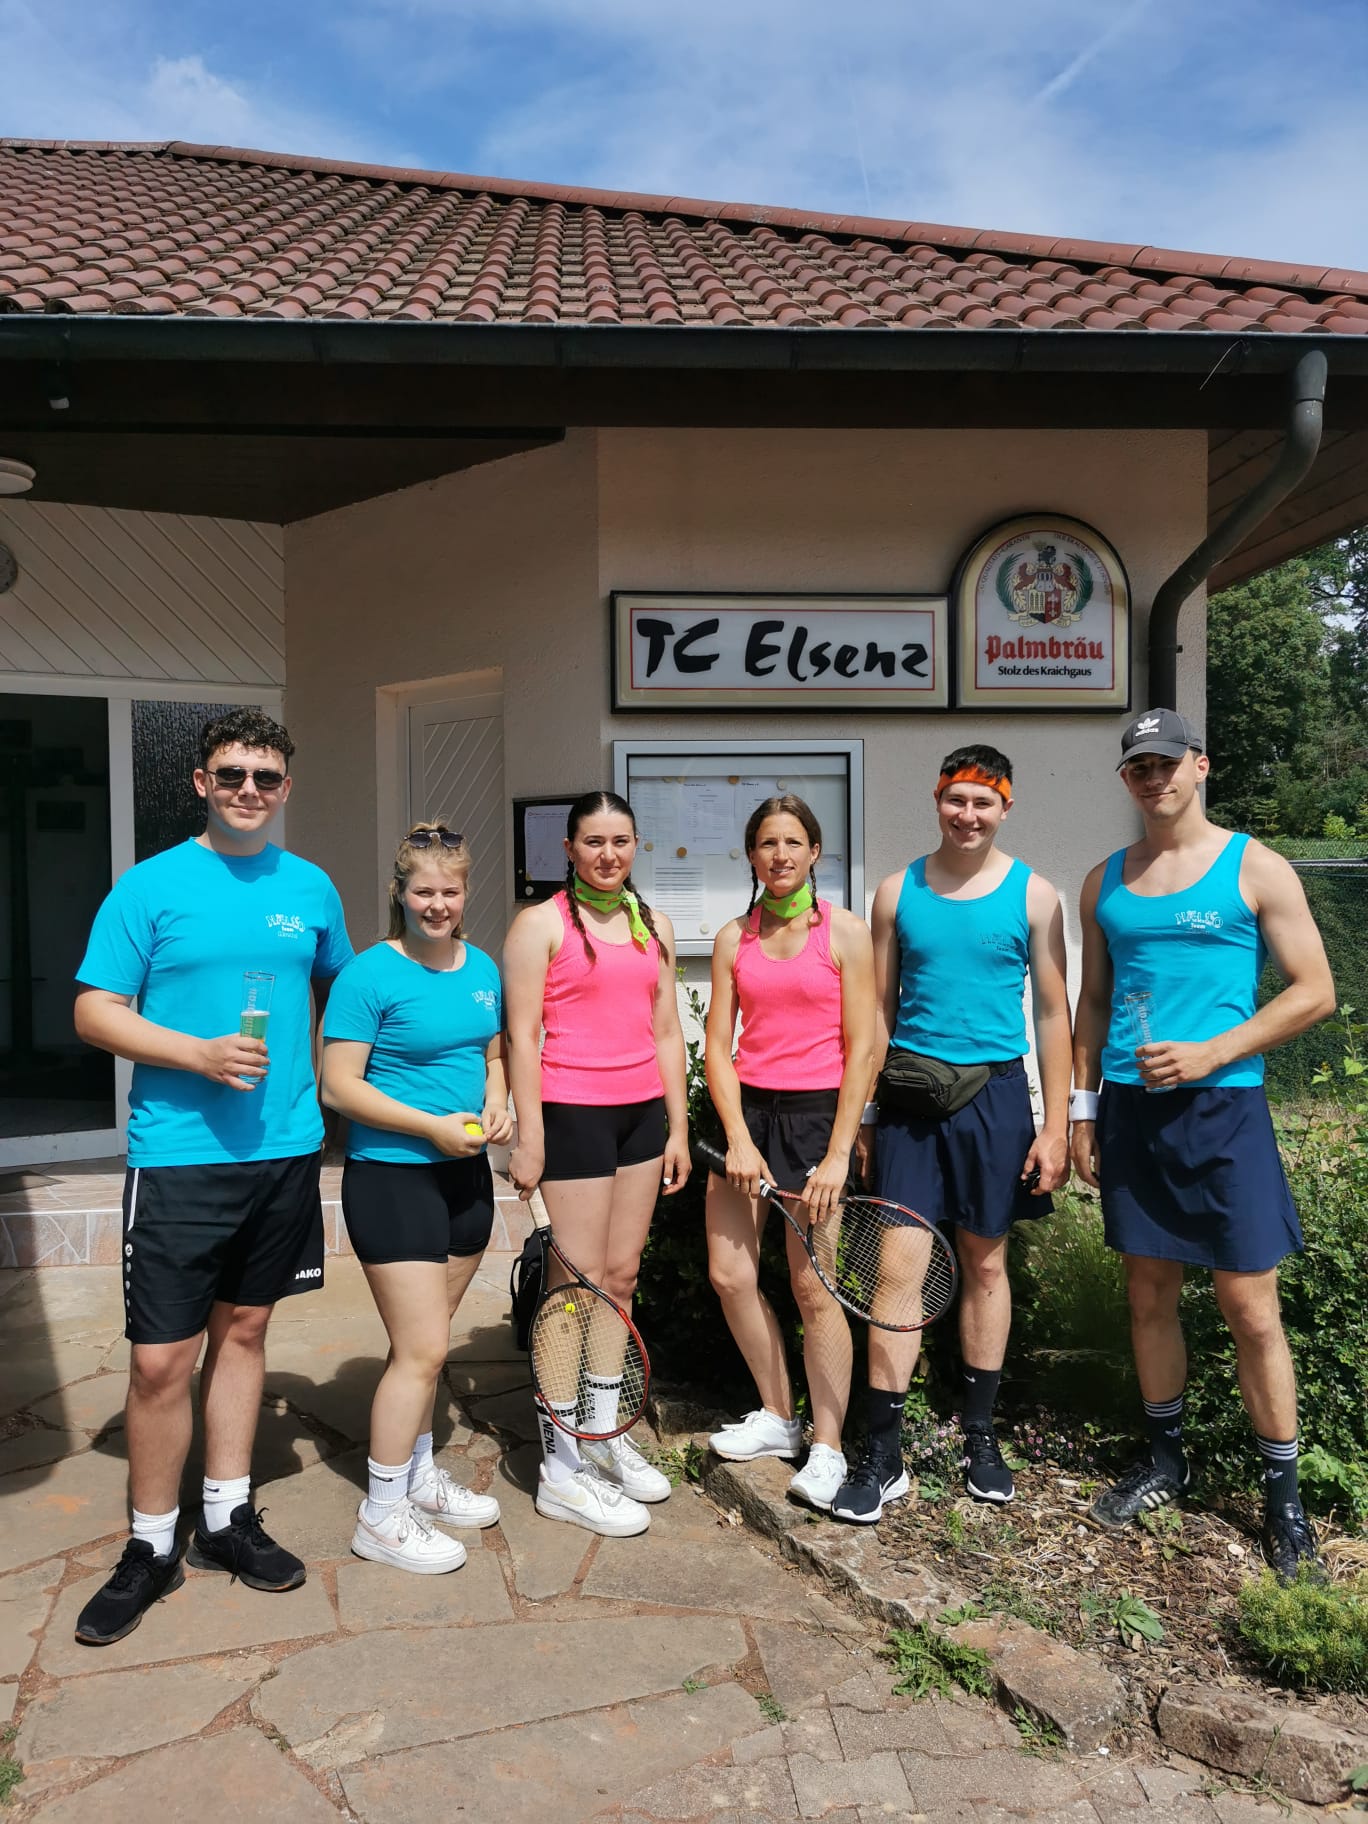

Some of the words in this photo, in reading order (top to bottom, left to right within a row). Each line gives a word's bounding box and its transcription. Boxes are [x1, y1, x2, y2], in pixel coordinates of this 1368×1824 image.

[636, 618, 719, 677] TC
[744, 620, 929, 682] Elsenz
[984, 634, 1104, 665] Palmbräu
[998, 665, 1022, 676] Stolz
[1023, 665, 1040, 676] des
[1040, 665, 1093, 679] Kraichgaus
[295, 1267, 321, 1280] JAKO
[541, 1419, 556, 1454] NENA
